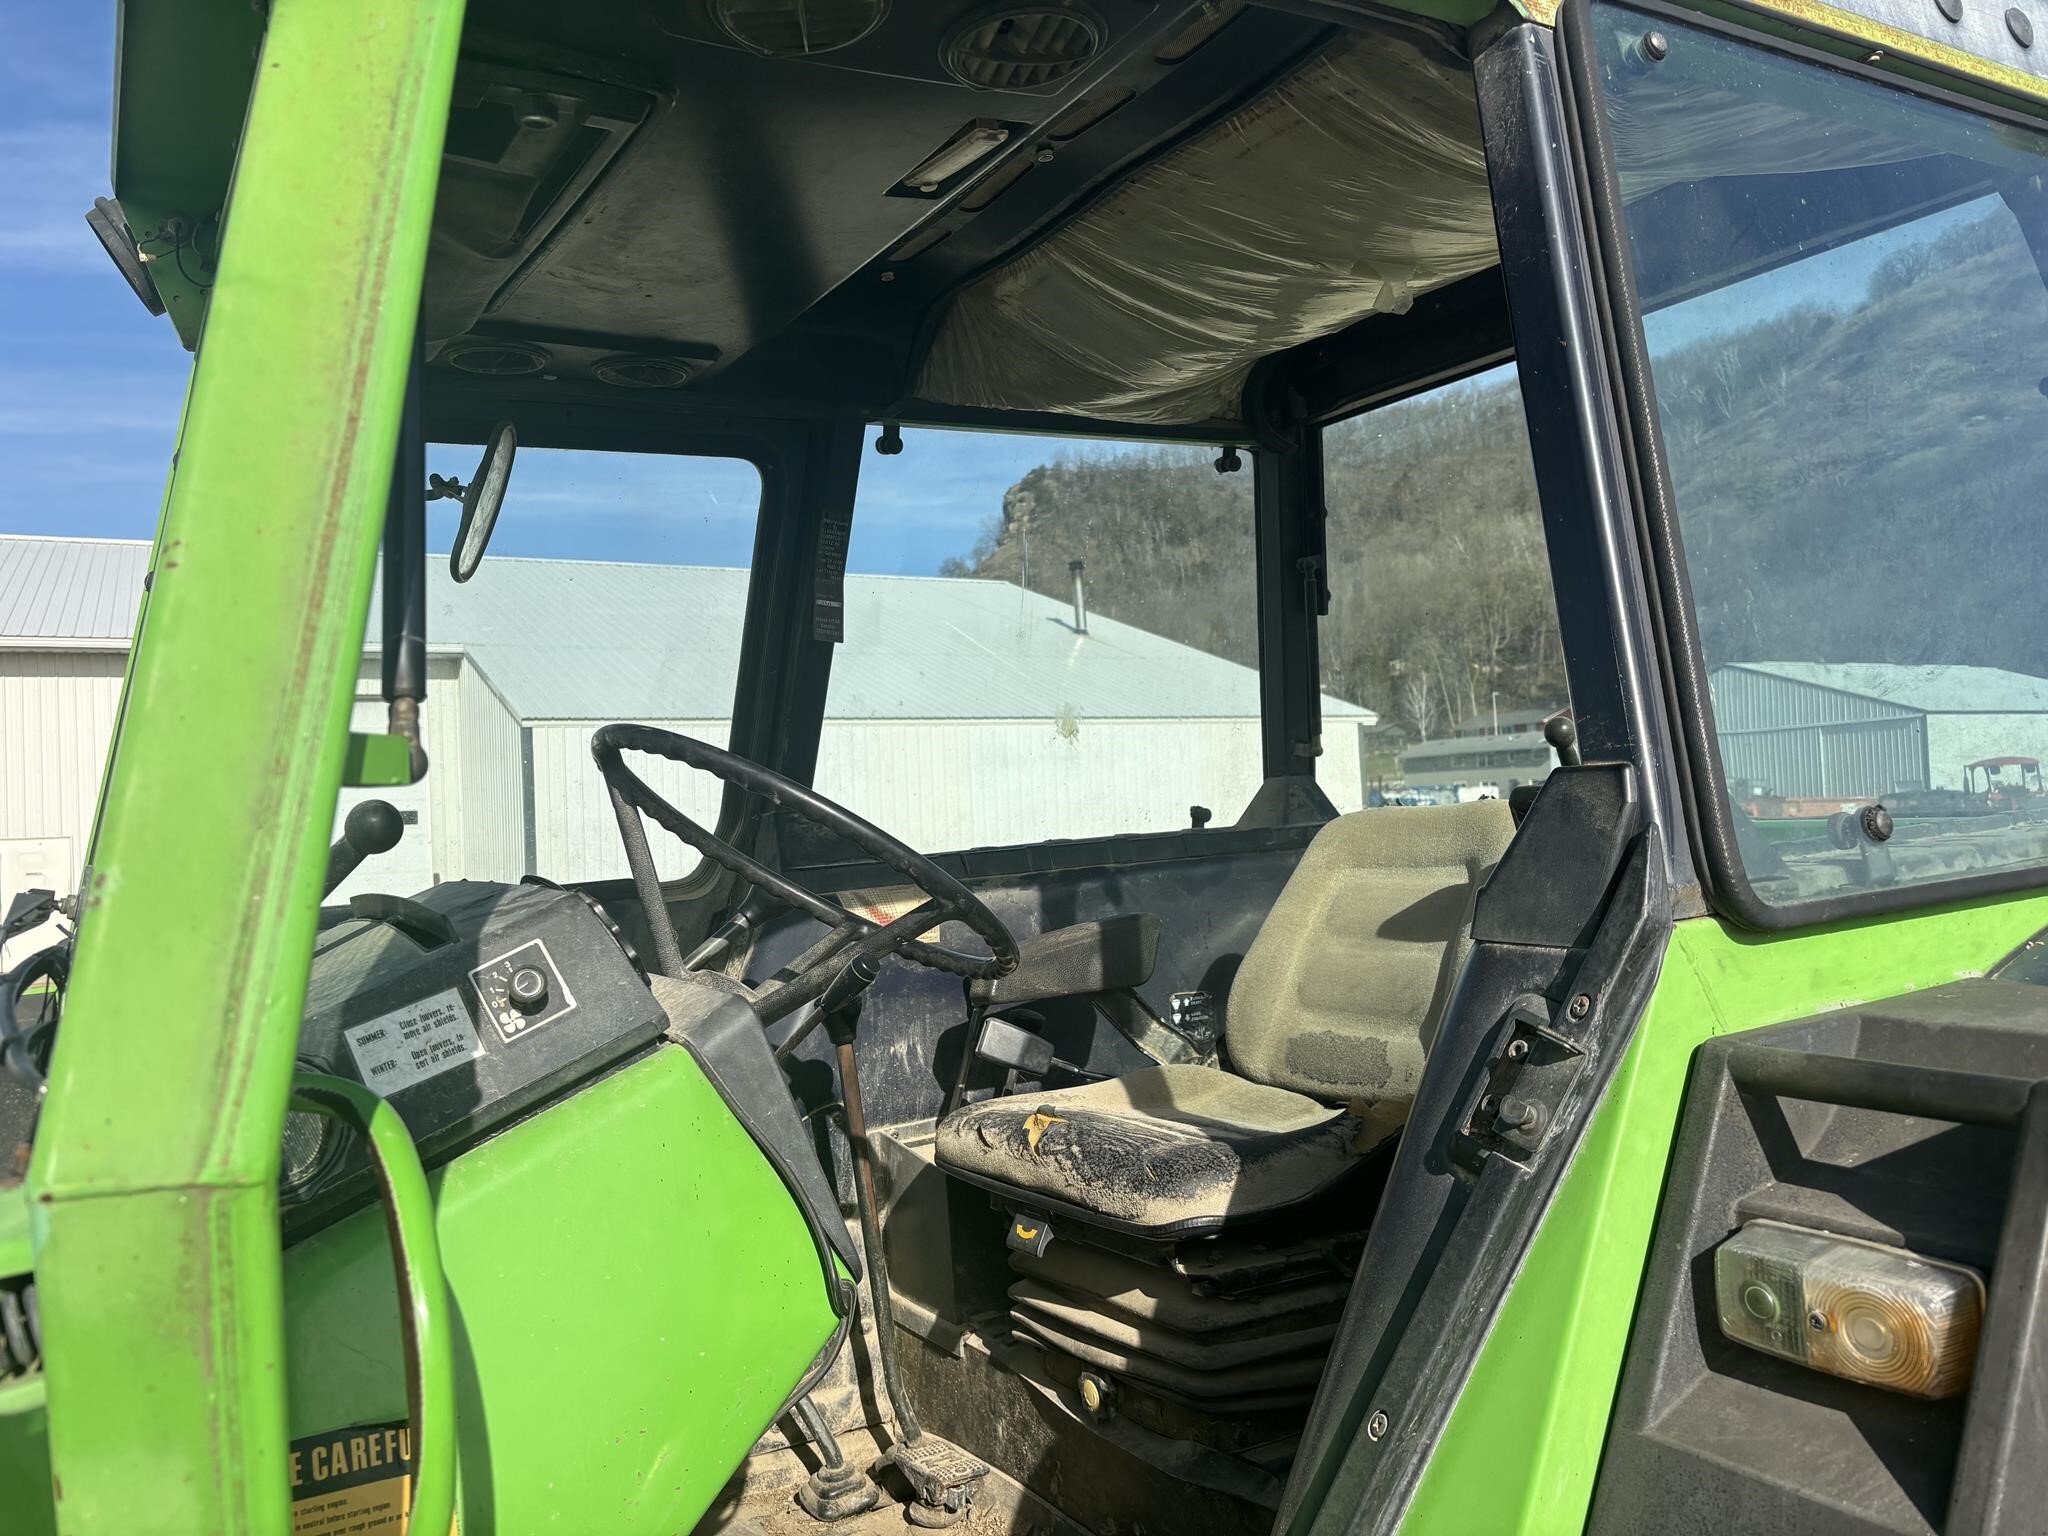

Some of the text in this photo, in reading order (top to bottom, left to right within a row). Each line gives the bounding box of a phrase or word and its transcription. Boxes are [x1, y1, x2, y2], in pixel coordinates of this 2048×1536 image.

[399, 1018, 418, 1030] Close
[446, 1003, 456, 1012] re-
[356, 1029, 388, 1047] SUMMER:
[403, 1030, 421, 1040] move
[423, 1024, 432, 1033] air
[411, 1048, 428, 1060] Open
[415, 1060, 429, 1070] sert
[431, 1054, 440, 1063] air
[370, 1060, 398, 1076] WINTER:
[289, 1428, 411, 1486] E CAREFU
